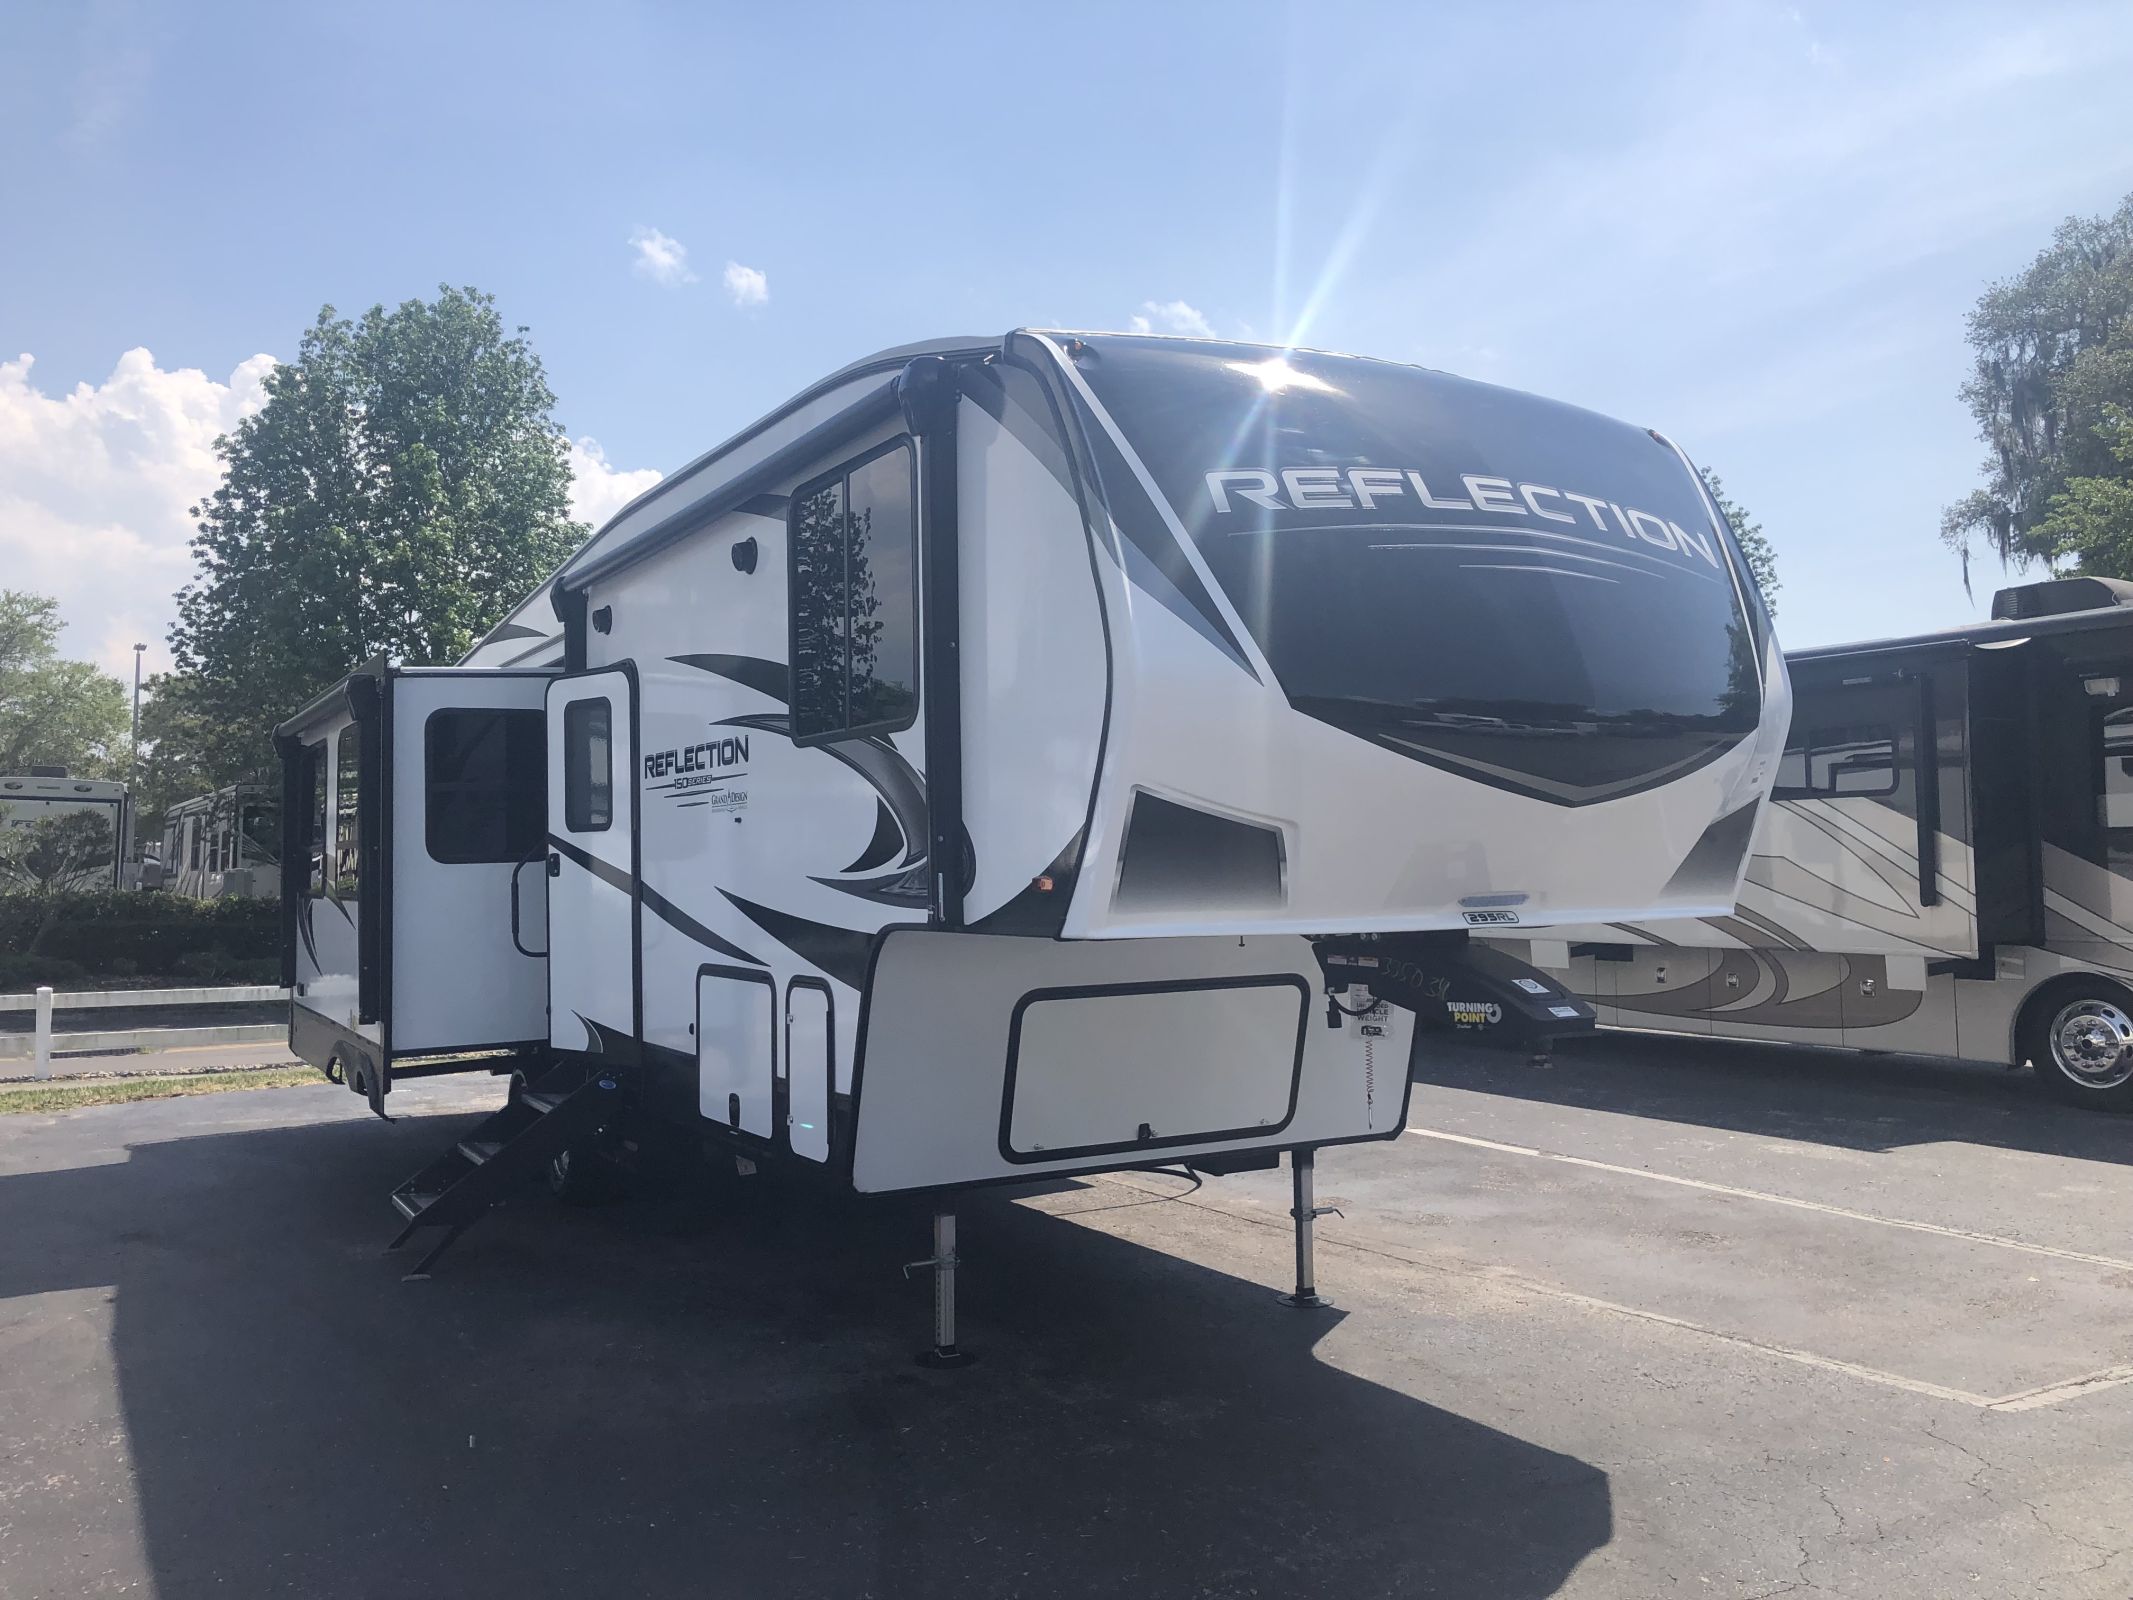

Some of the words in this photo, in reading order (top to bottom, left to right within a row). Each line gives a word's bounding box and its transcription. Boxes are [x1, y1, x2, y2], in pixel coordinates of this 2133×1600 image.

[1204, 466, 1720, 569] REFLECTION
[644, 734, 749, 779] REFLECTION
[688, 774, 712, 787] SERIES
[1446, 1001, 1493, 1014] TURNING
[1454, 1012, 1486, 1024] POINT
